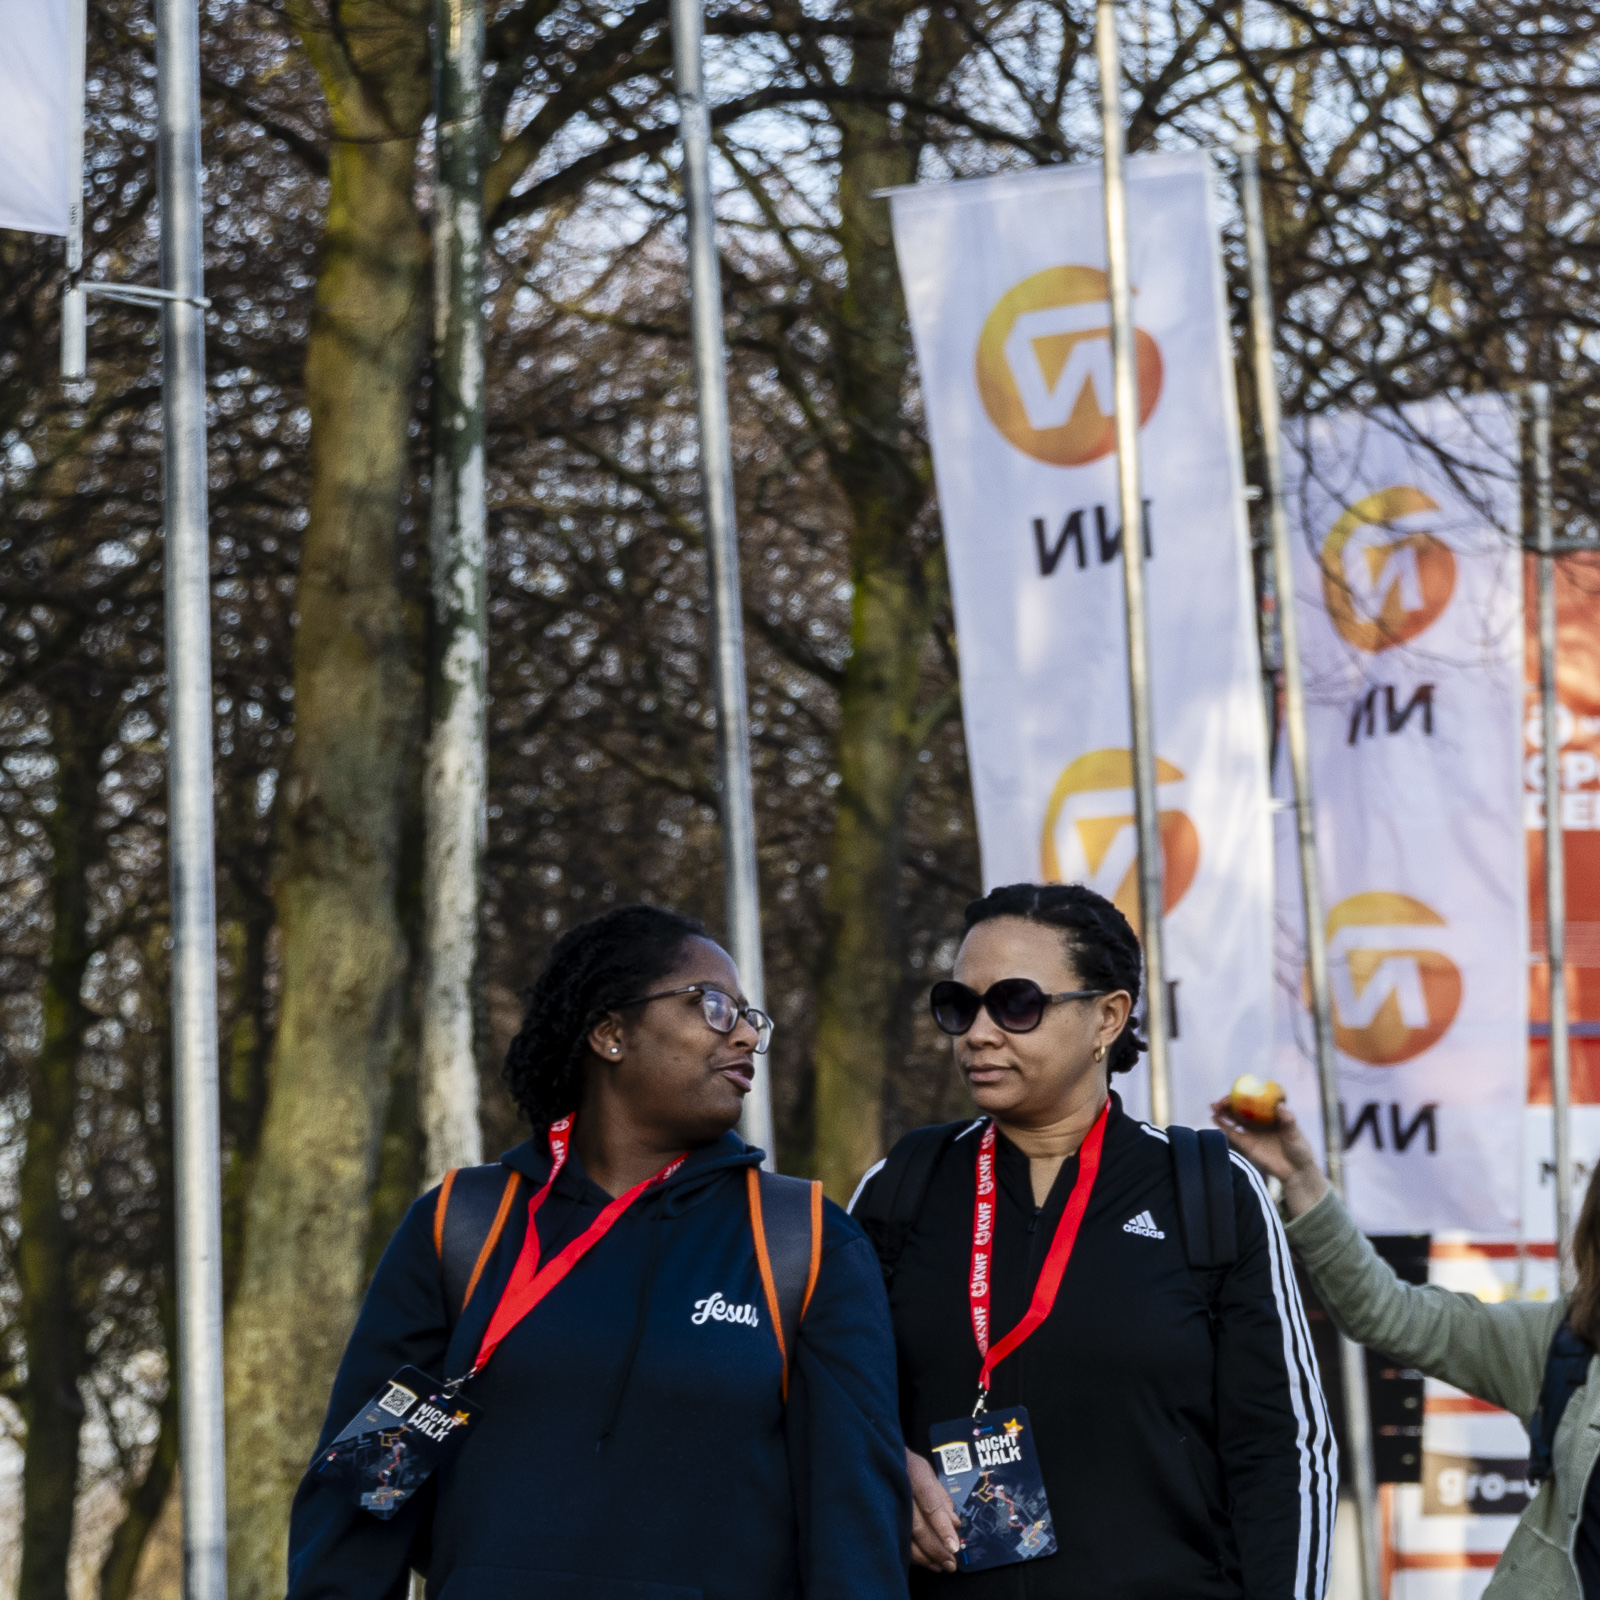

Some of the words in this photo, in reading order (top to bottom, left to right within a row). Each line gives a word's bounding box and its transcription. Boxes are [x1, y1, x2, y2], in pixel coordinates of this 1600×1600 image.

[979, 1153, 992, 1182] KWF
[977, 1202, 992, 1231] KWF
[1123, 1223, 1165, 1239] adidas
[973, 1253, 988, 1282] KWF
[691, 1292, 759, 1328] Jesus
[408, 1411, 449, 1442] WALK
[974, 1434, 1018, 1453] NIGHT
[977, 1446, 1022, 1468] WALK
